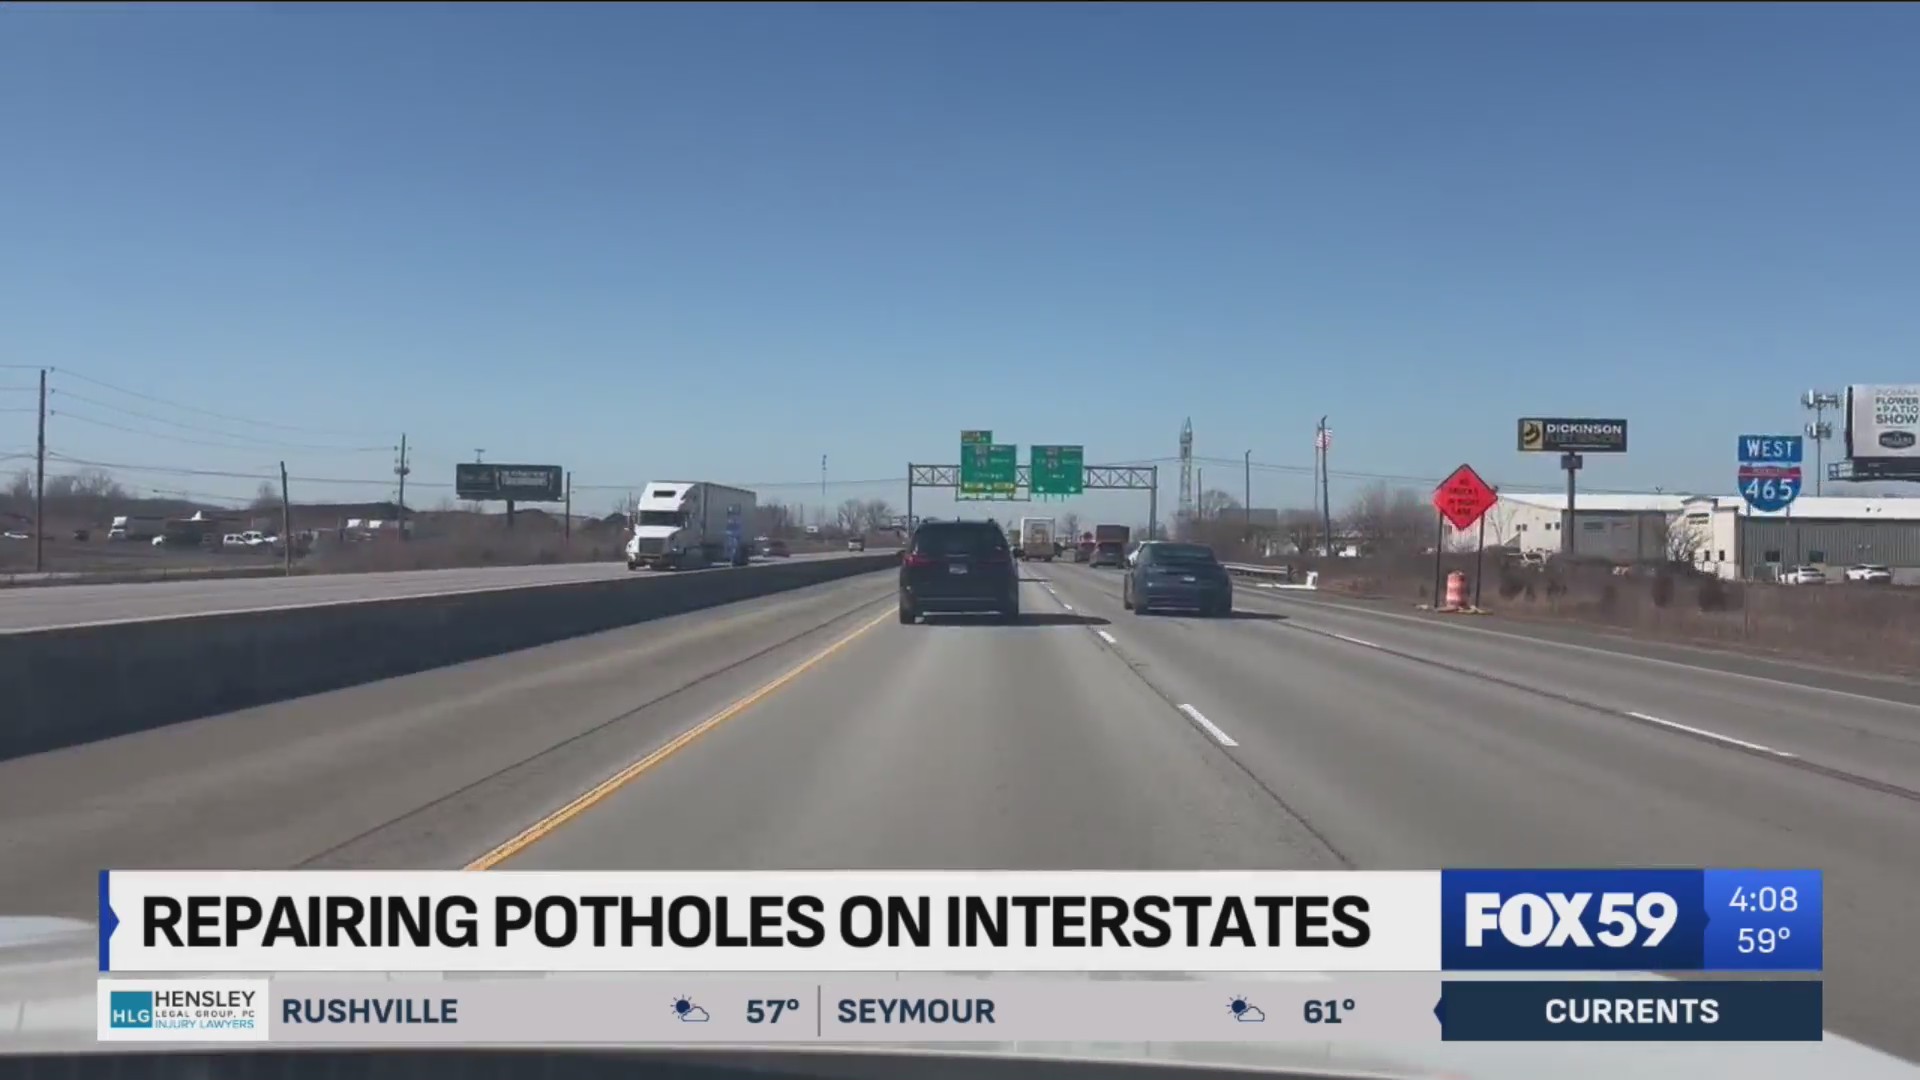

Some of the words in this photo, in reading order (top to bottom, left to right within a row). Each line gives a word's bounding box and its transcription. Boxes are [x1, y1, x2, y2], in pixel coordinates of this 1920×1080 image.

[1875, 397, 1920, 405] FLOWER
[1875, 414, 1920, 424] SHOW
[1546, 424, 1622, 434] DICKINSON
[1746, 439, 1793, 457] WEST
[1745, 477, 1793, 500] 465
